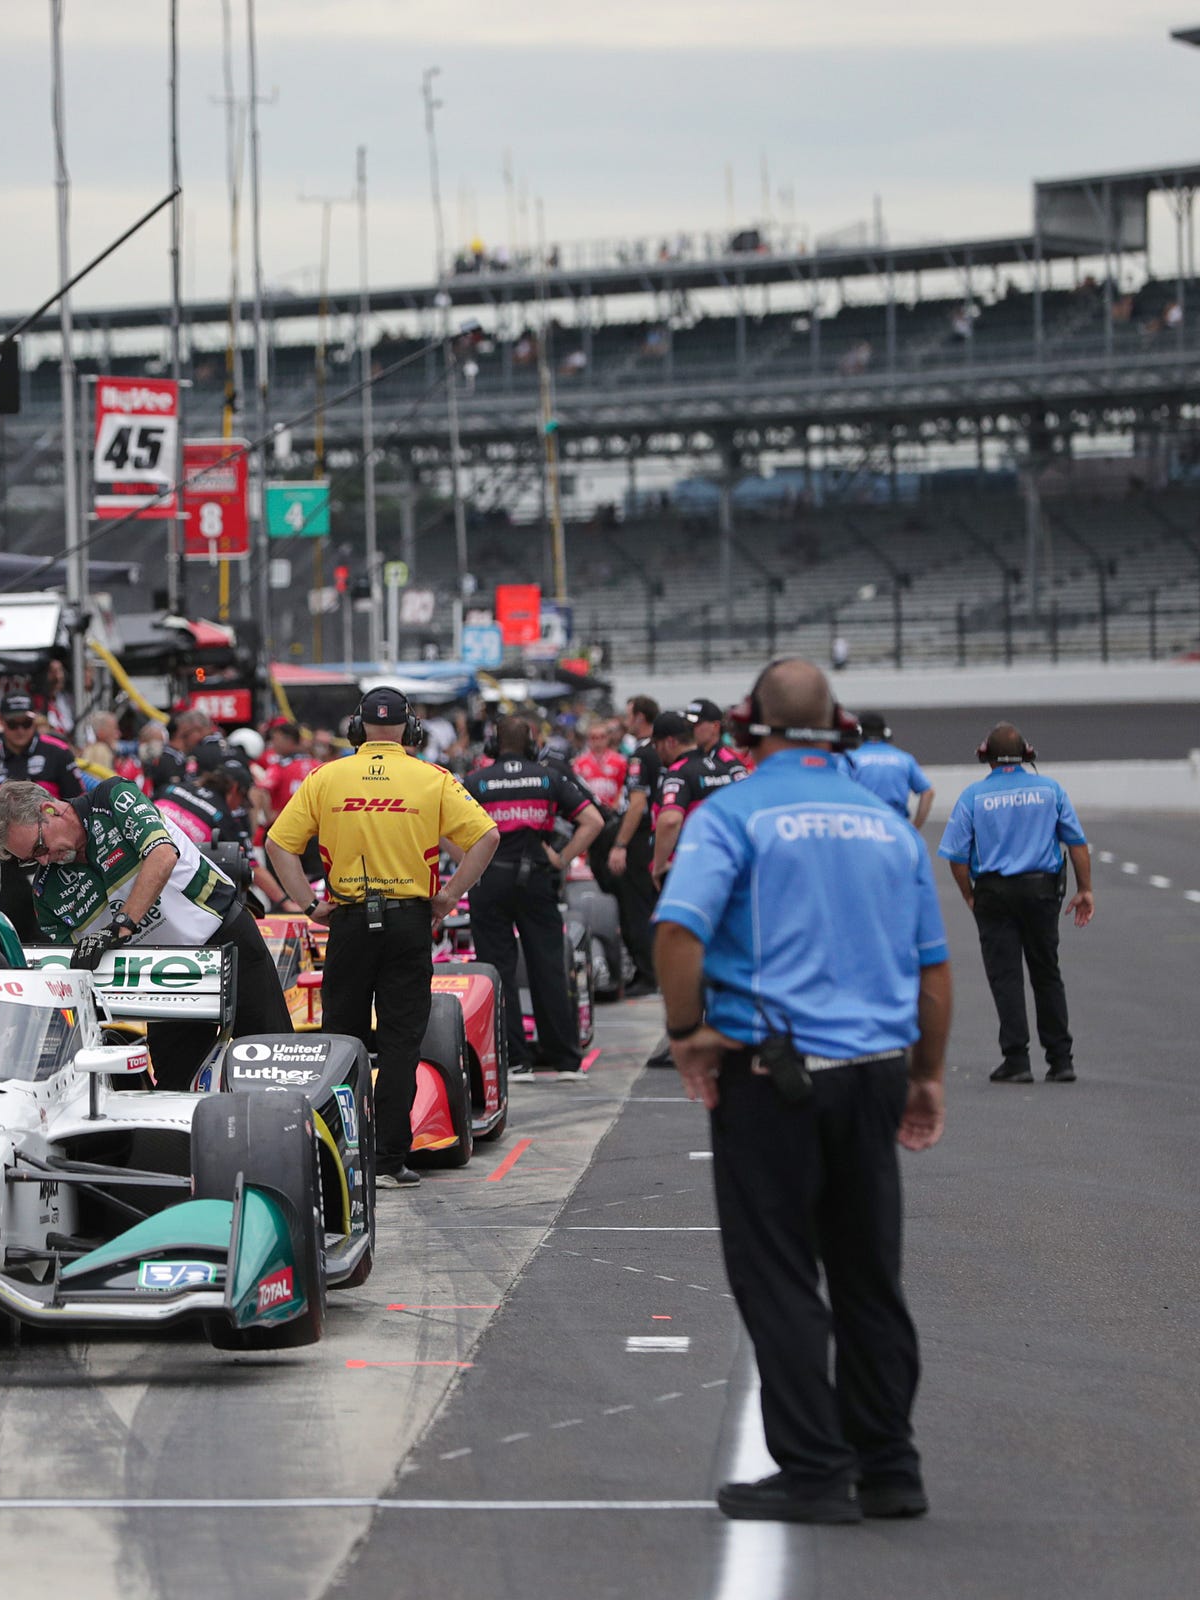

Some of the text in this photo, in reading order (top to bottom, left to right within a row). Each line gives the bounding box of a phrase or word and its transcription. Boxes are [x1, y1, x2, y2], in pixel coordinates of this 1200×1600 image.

[104, 427, 165, 469] 45
[285, 502, 305, 531] 4
[487, 777, 542, 790] SiriusXM
[342, 798, 408, 813] DHL
[984, 791, 1045, 811] OFFICIAL
[489, 806, 548, 823] utoNation
[775, 812, 897, 842] OFFICIAL
[272, 1044, 323, 1054] United
[271, 1054, 326, 1063] Rentals
[233, 1066, 313, 1080] Luther
[109, 1118, 192, 1126] Firesto
[258, 1279, 291, 1307] TOTAL
